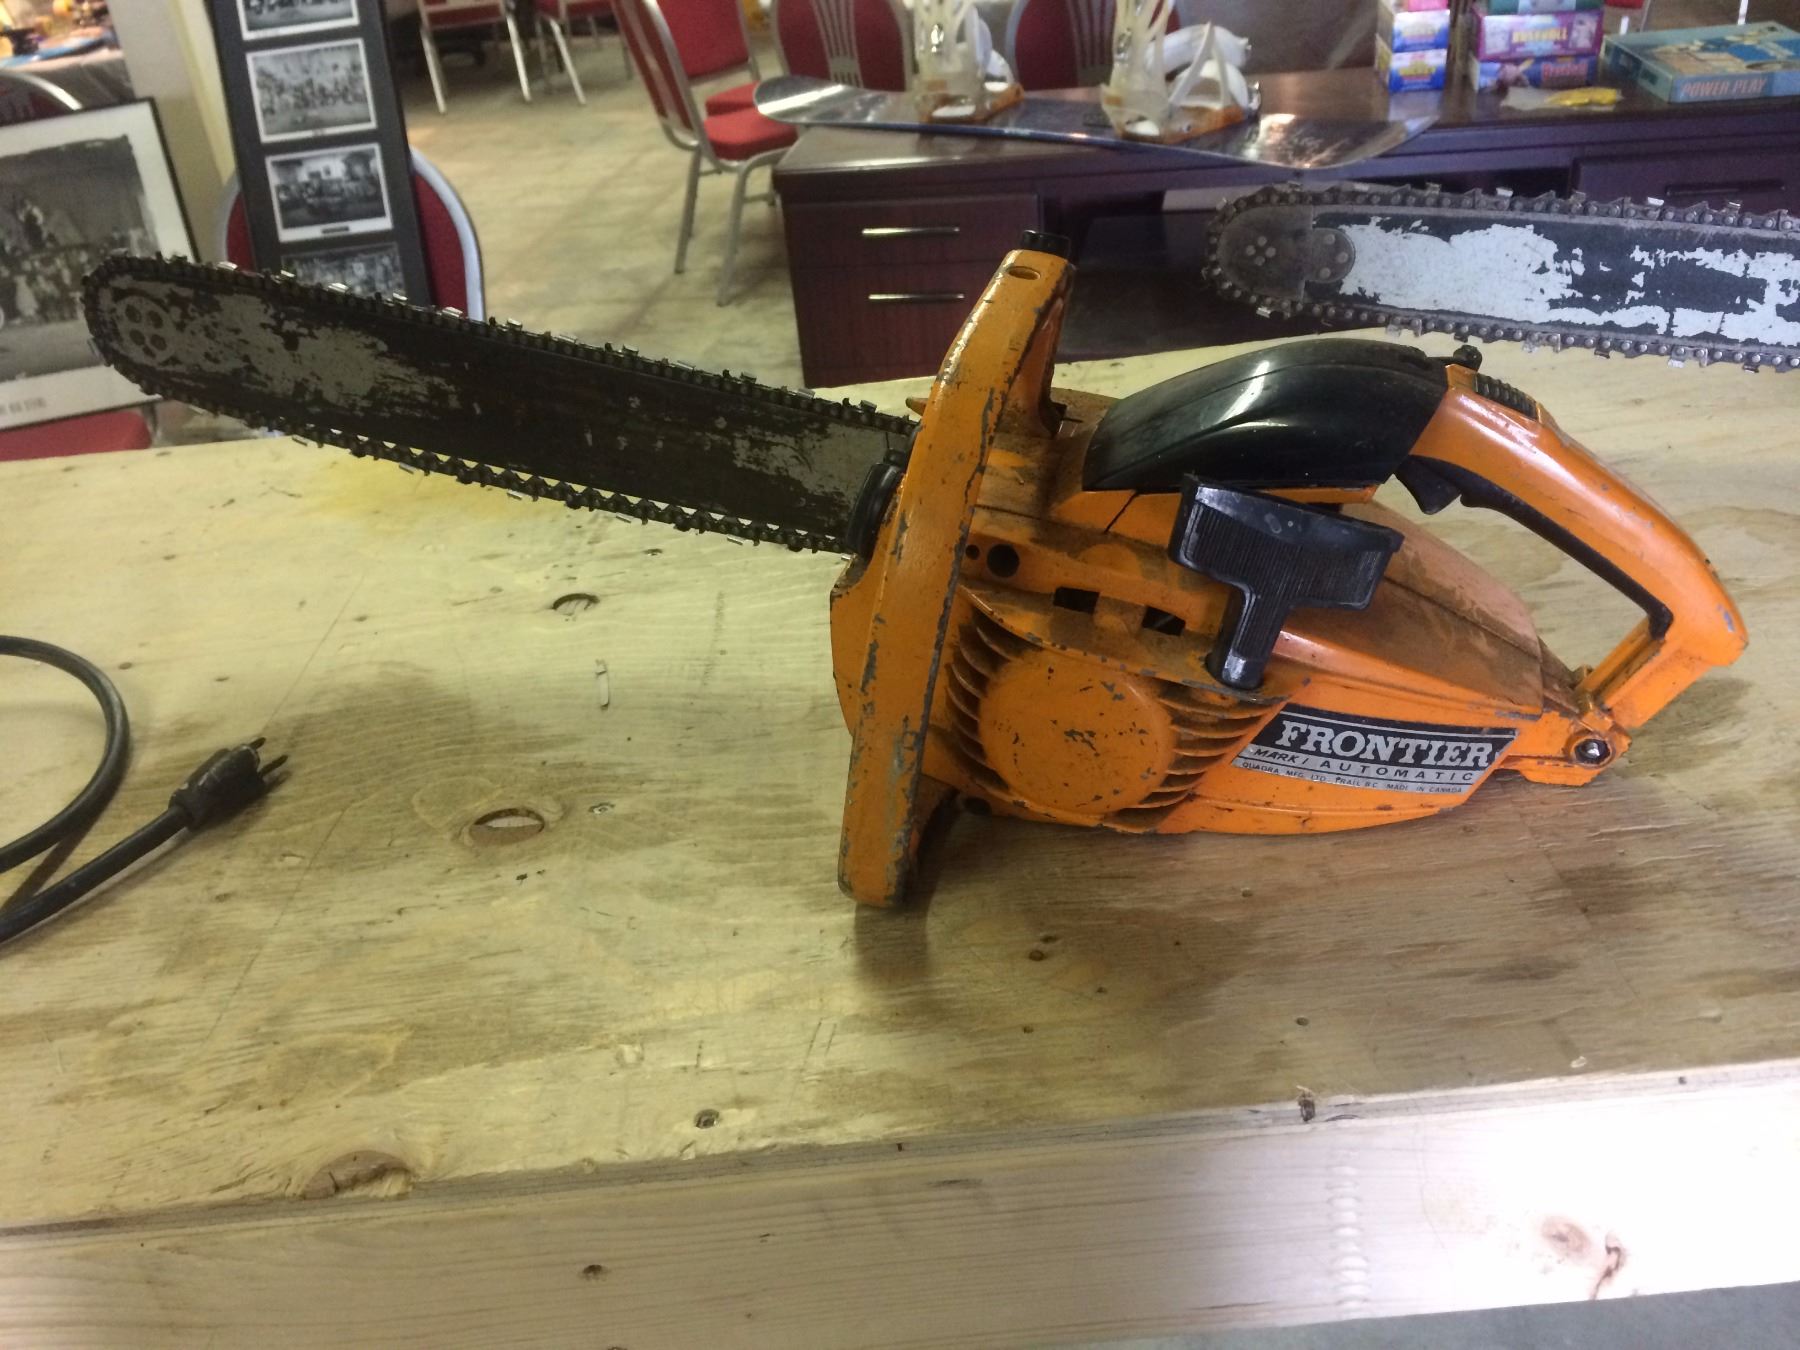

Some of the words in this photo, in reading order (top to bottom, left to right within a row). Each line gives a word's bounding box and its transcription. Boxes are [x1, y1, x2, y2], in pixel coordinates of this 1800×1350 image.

[1681, 79, 1729, 97] POWER
[1732, 77, 1767, 93] PLAY
[1275, 720, 1493, 768] FRONTIER
[1242, 761, 1279, 774] QUADRA
[1254, 748, 1300, 764] MARK
[1320, 760, 1474, 781] AUTOMATIC
